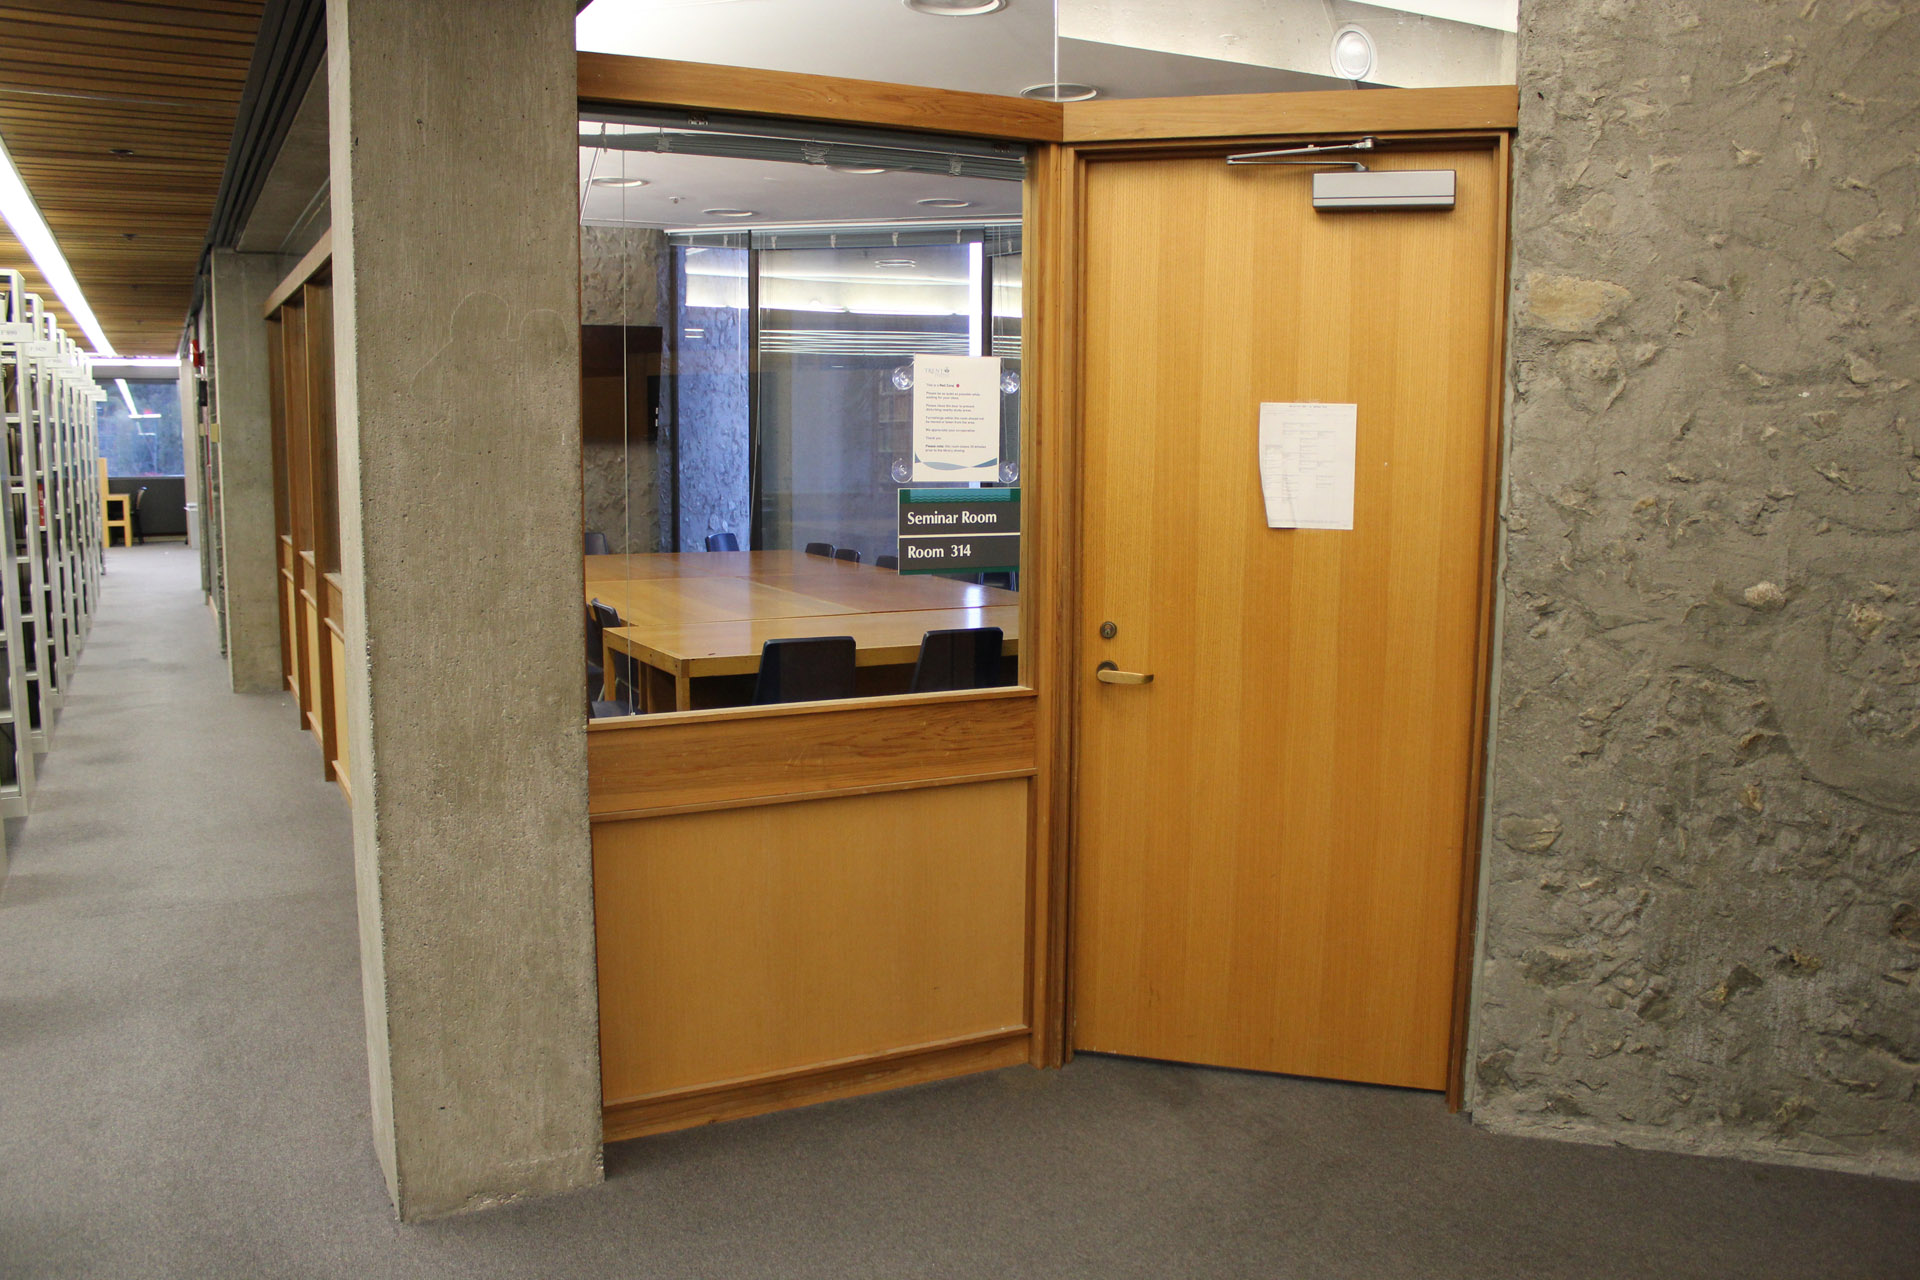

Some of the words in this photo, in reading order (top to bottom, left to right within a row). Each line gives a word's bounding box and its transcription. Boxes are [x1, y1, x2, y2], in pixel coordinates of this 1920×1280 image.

[907, 510, 959, 525] Seminar
[961, 510, 997, 524] Room
[907, 545, 945, 559] Room
[950, 544, 972, 557] 314
